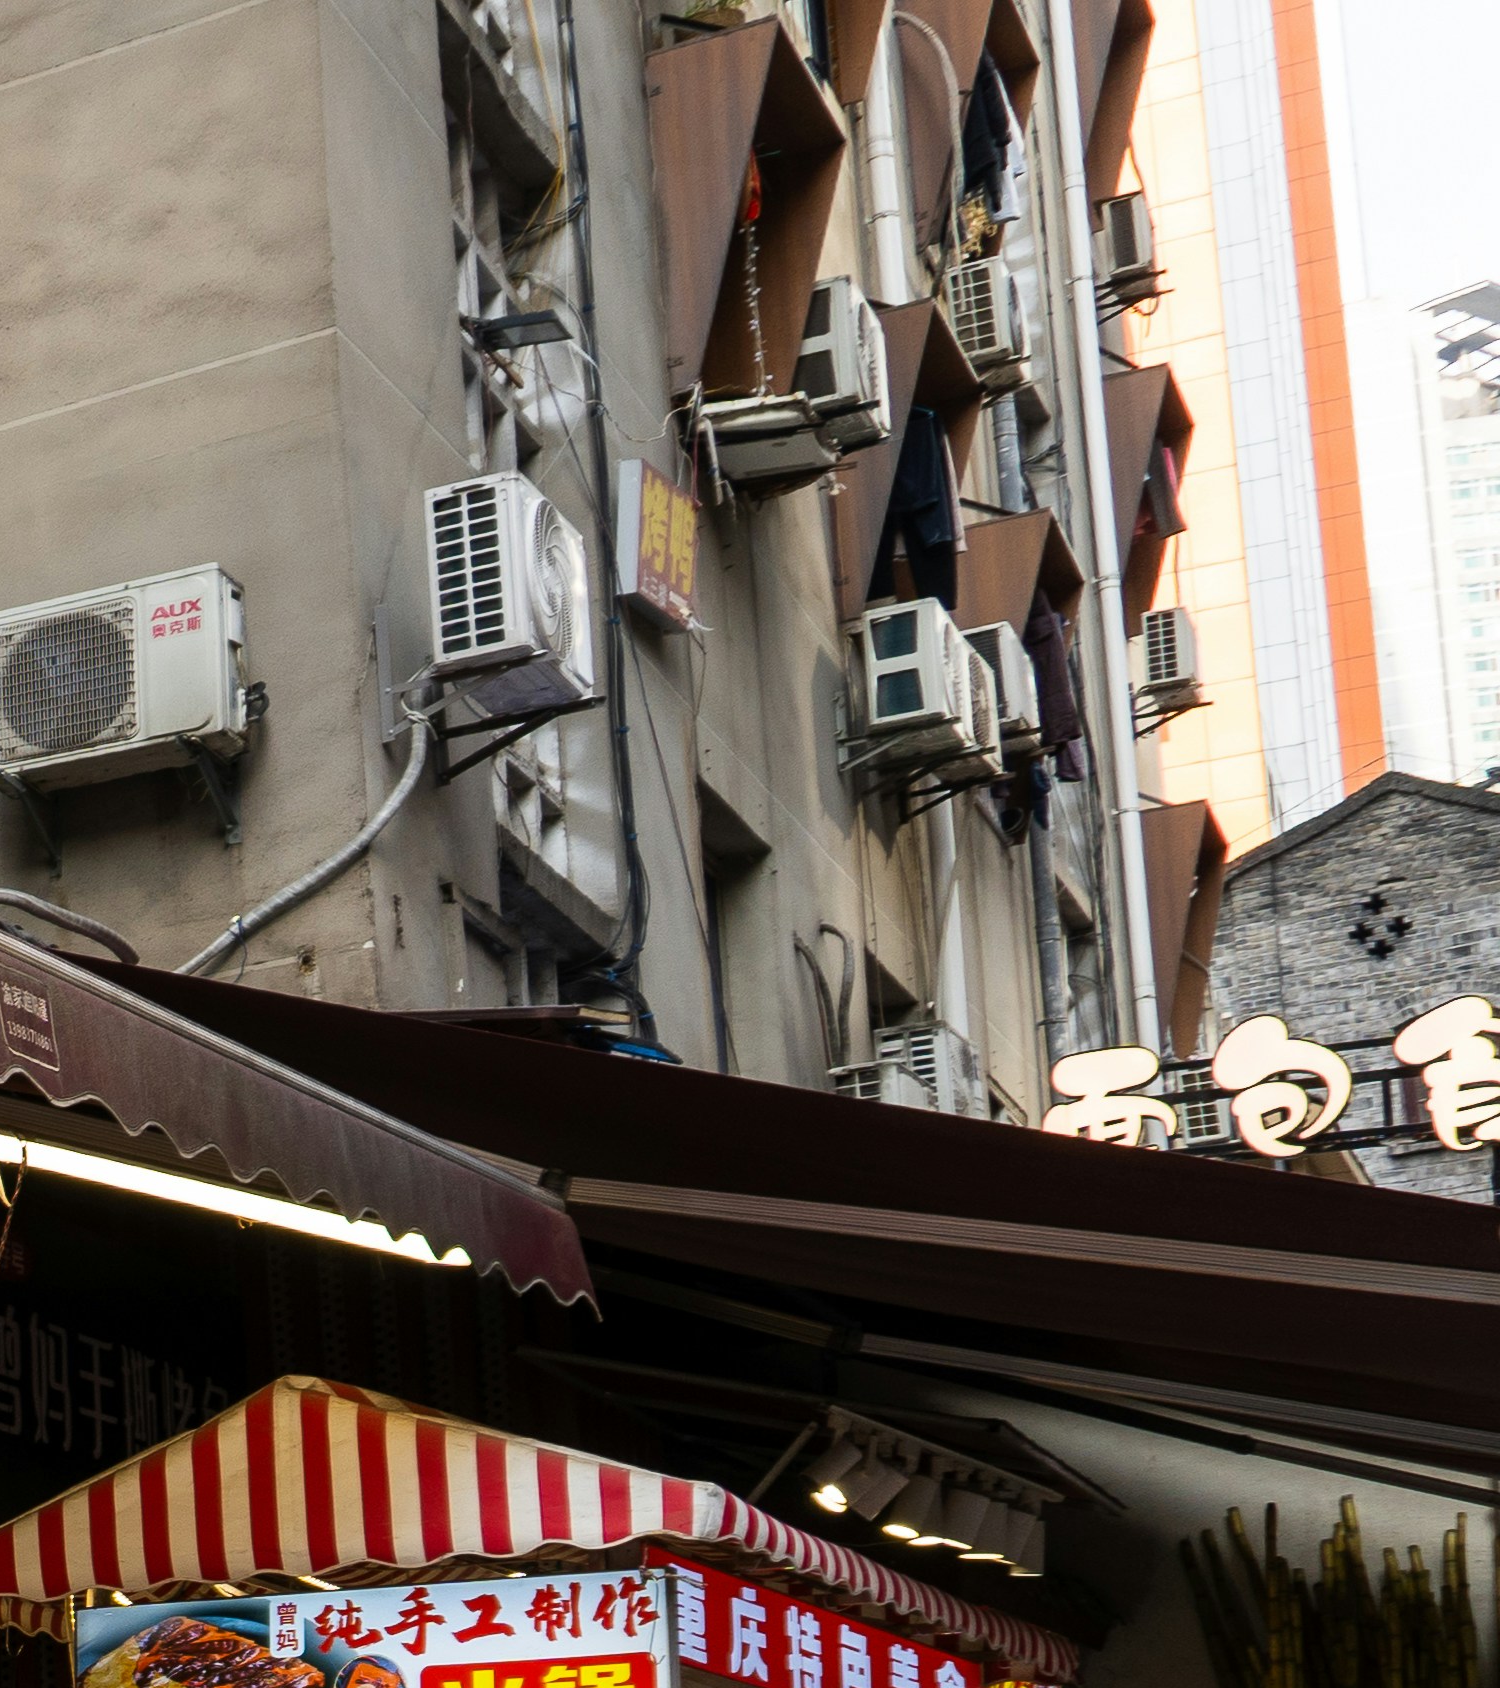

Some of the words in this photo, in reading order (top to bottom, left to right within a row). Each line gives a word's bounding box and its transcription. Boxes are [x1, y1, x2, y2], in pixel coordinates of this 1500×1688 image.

[151, 597, 203, 622] AUX
[275, 1601, 301, 1653] 曾妈
[313, 1576, 662, 1658] 纯手工制作
